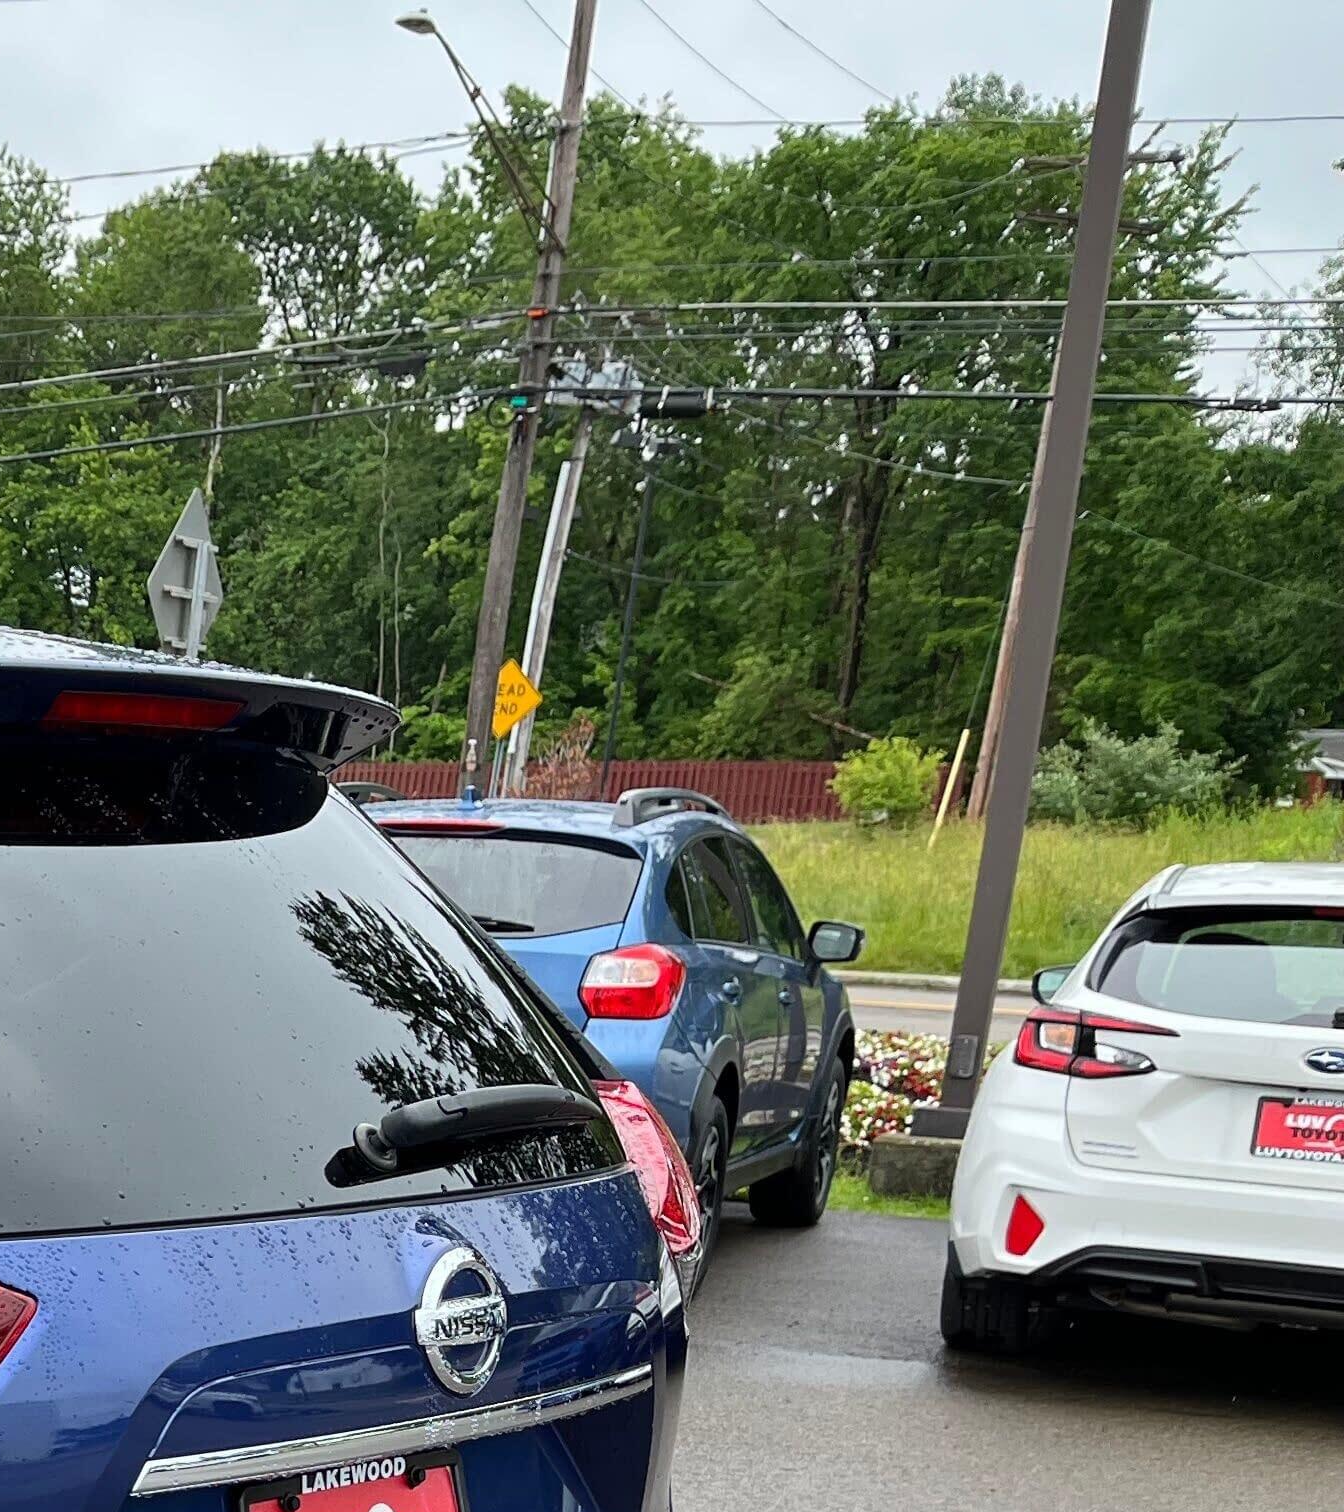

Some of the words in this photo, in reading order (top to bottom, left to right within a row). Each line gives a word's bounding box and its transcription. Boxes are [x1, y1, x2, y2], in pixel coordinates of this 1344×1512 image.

[497, 682, 526, 697] EAD
[1284, 1112, 1327, 1130] LUV
[1255, 1145, 1344, 1163] LUVTOYOTA
[301, 1456, 407, 1495] LAKEWOOD
